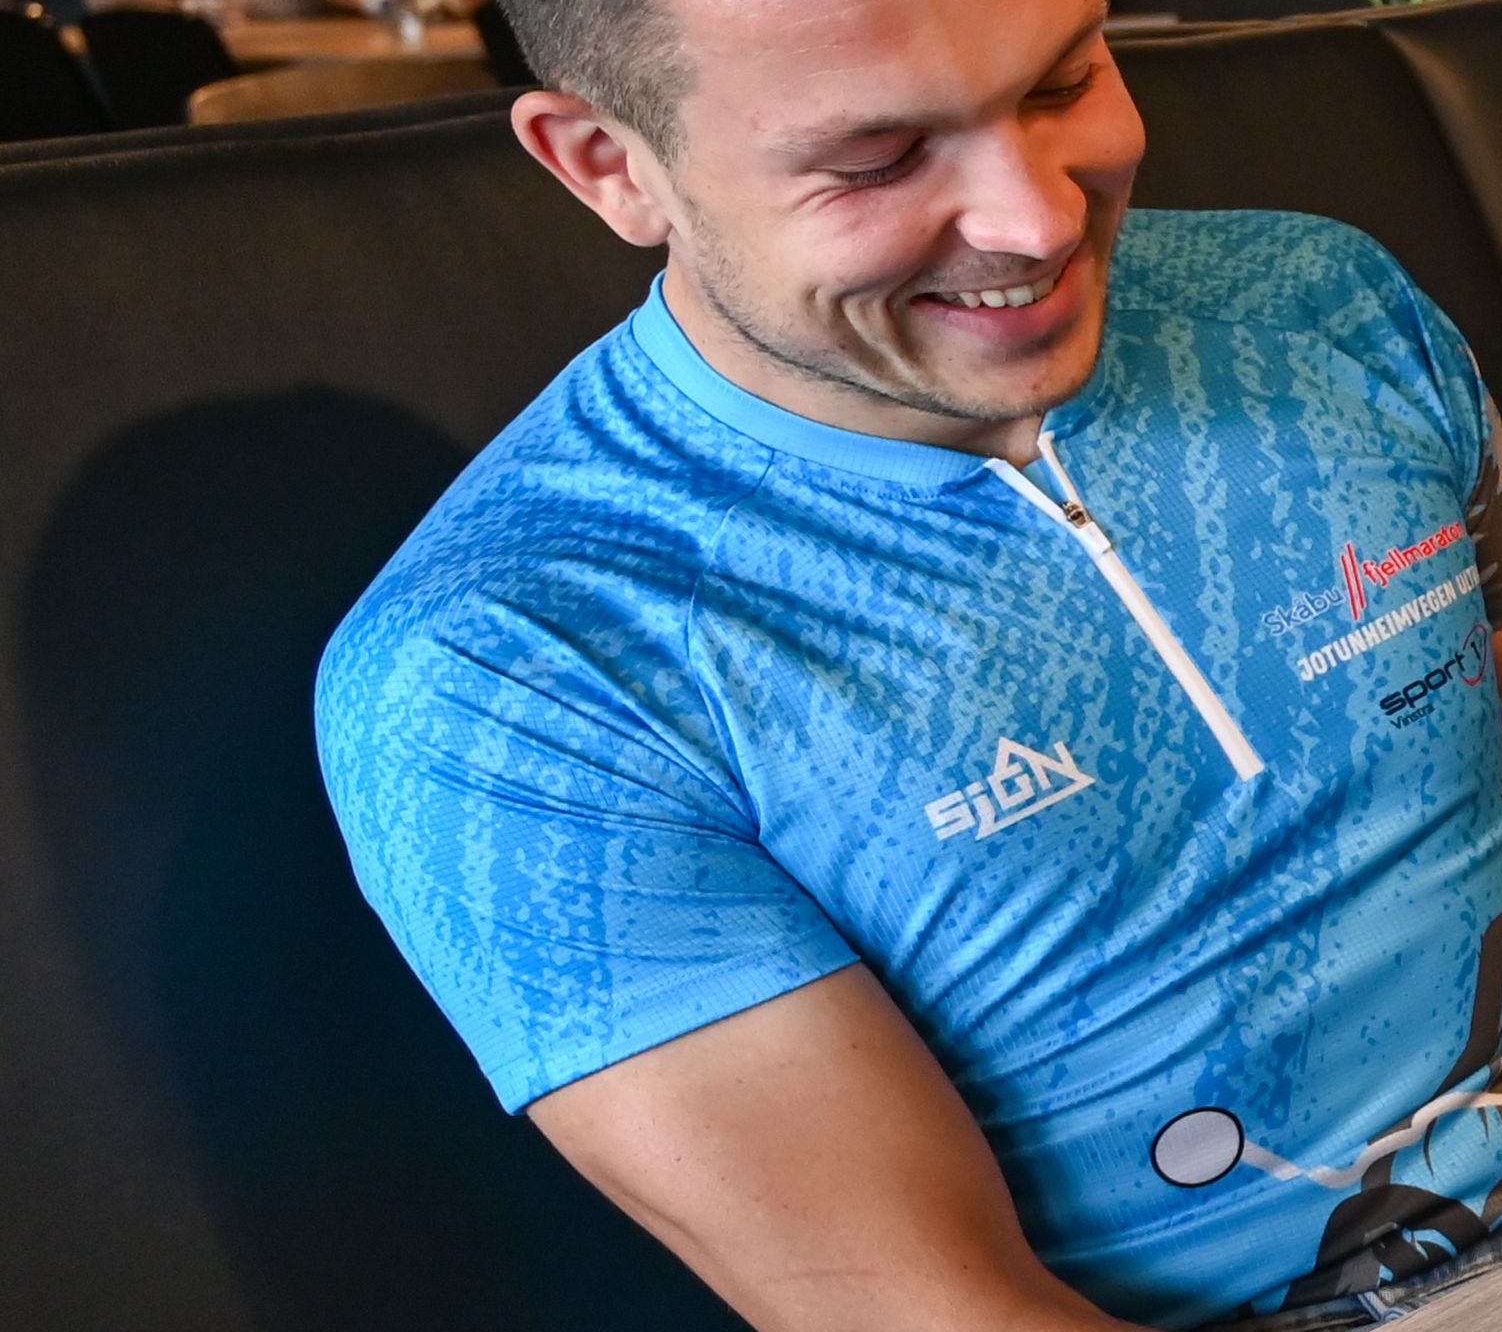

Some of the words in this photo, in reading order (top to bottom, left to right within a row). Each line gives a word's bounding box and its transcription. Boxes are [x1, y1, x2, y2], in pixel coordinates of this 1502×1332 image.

[1261, 585, 1345, 638] Skåbu
[1297, 580, 1457, 682] JOTUNHEIMVEGEN
[1380, 651, 1464, 716] sport
[1390, 703, 1436, 730] Vinstra
